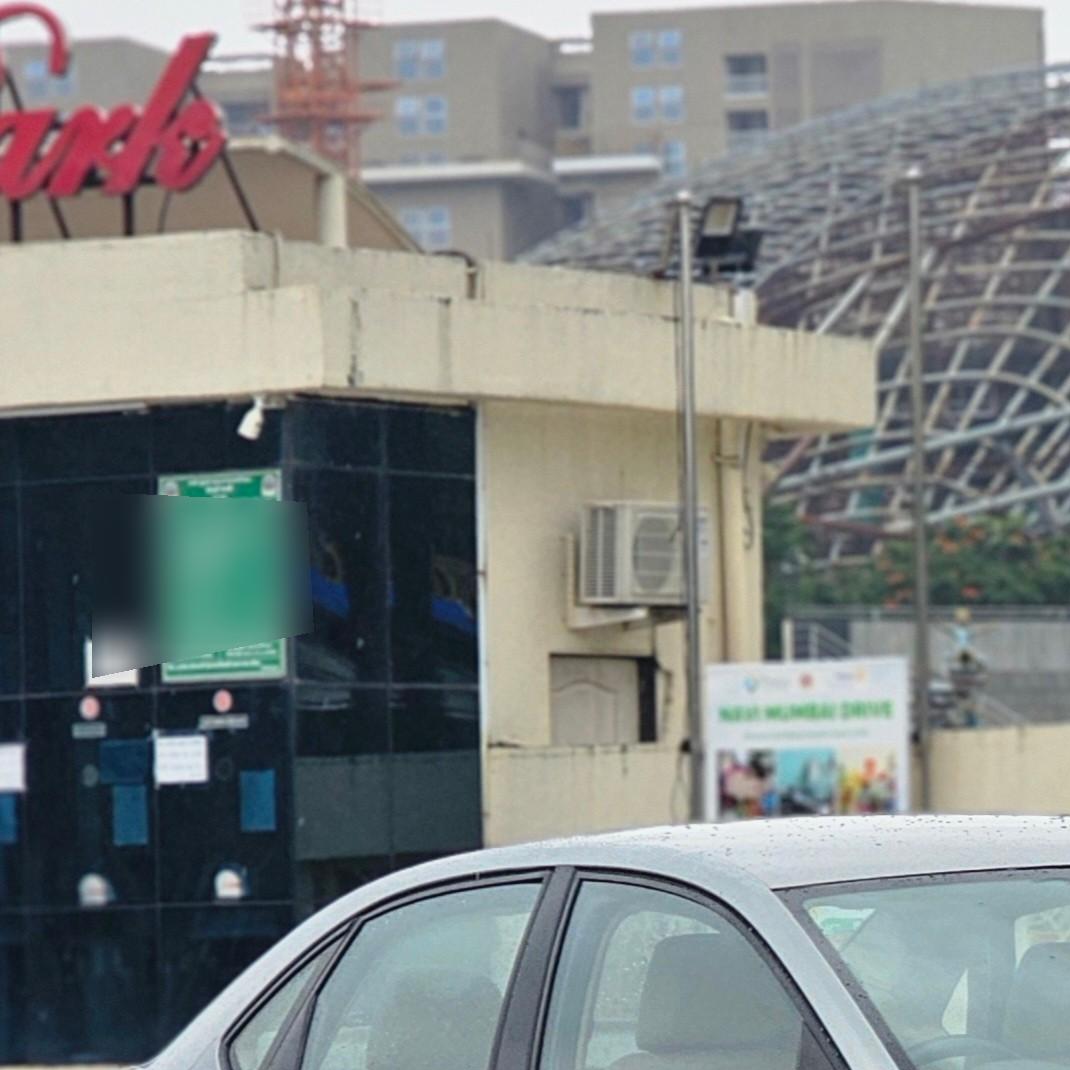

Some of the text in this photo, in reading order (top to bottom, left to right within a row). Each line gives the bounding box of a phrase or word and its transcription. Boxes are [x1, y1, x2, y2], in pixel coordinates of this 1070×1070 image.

[718, 700, 893, 722] NAVI MUMBAI DRIVE
